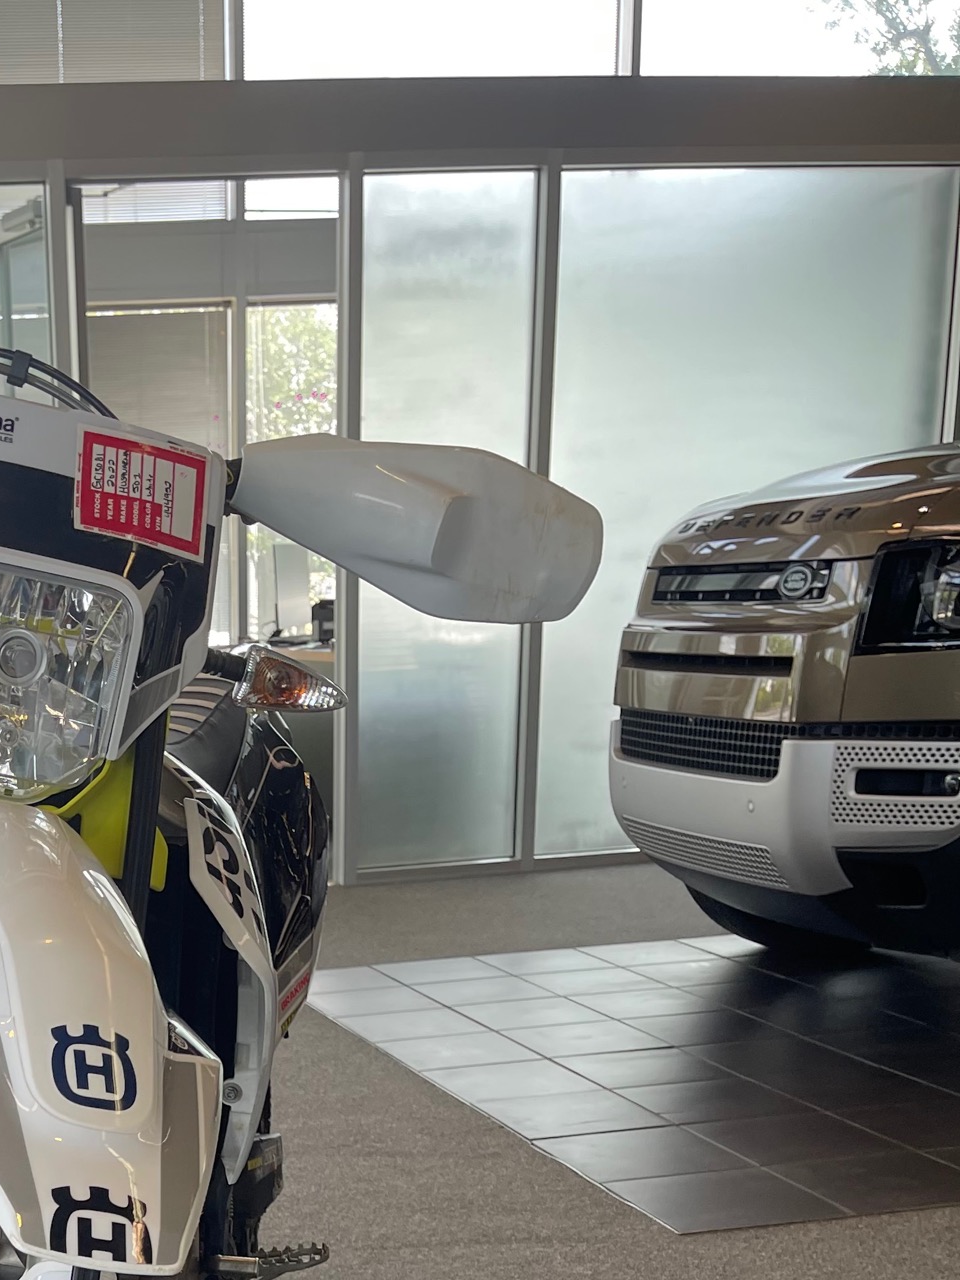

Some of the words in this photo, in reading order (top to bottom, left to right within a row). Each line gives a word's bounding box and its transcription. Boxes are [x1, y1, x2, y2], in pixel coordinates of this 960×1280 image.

[106, 459, 115, 487] 2022
[93, 493, 101, 518] STOCK
[106, 499, 114, 520] YEAR
[119, 500, 127, 523] MAKE
[132, 500, 140, 526] MODEL
[144, 502, 152, 529] COLOR
[677, 506, 862, 534] DEFENDER
